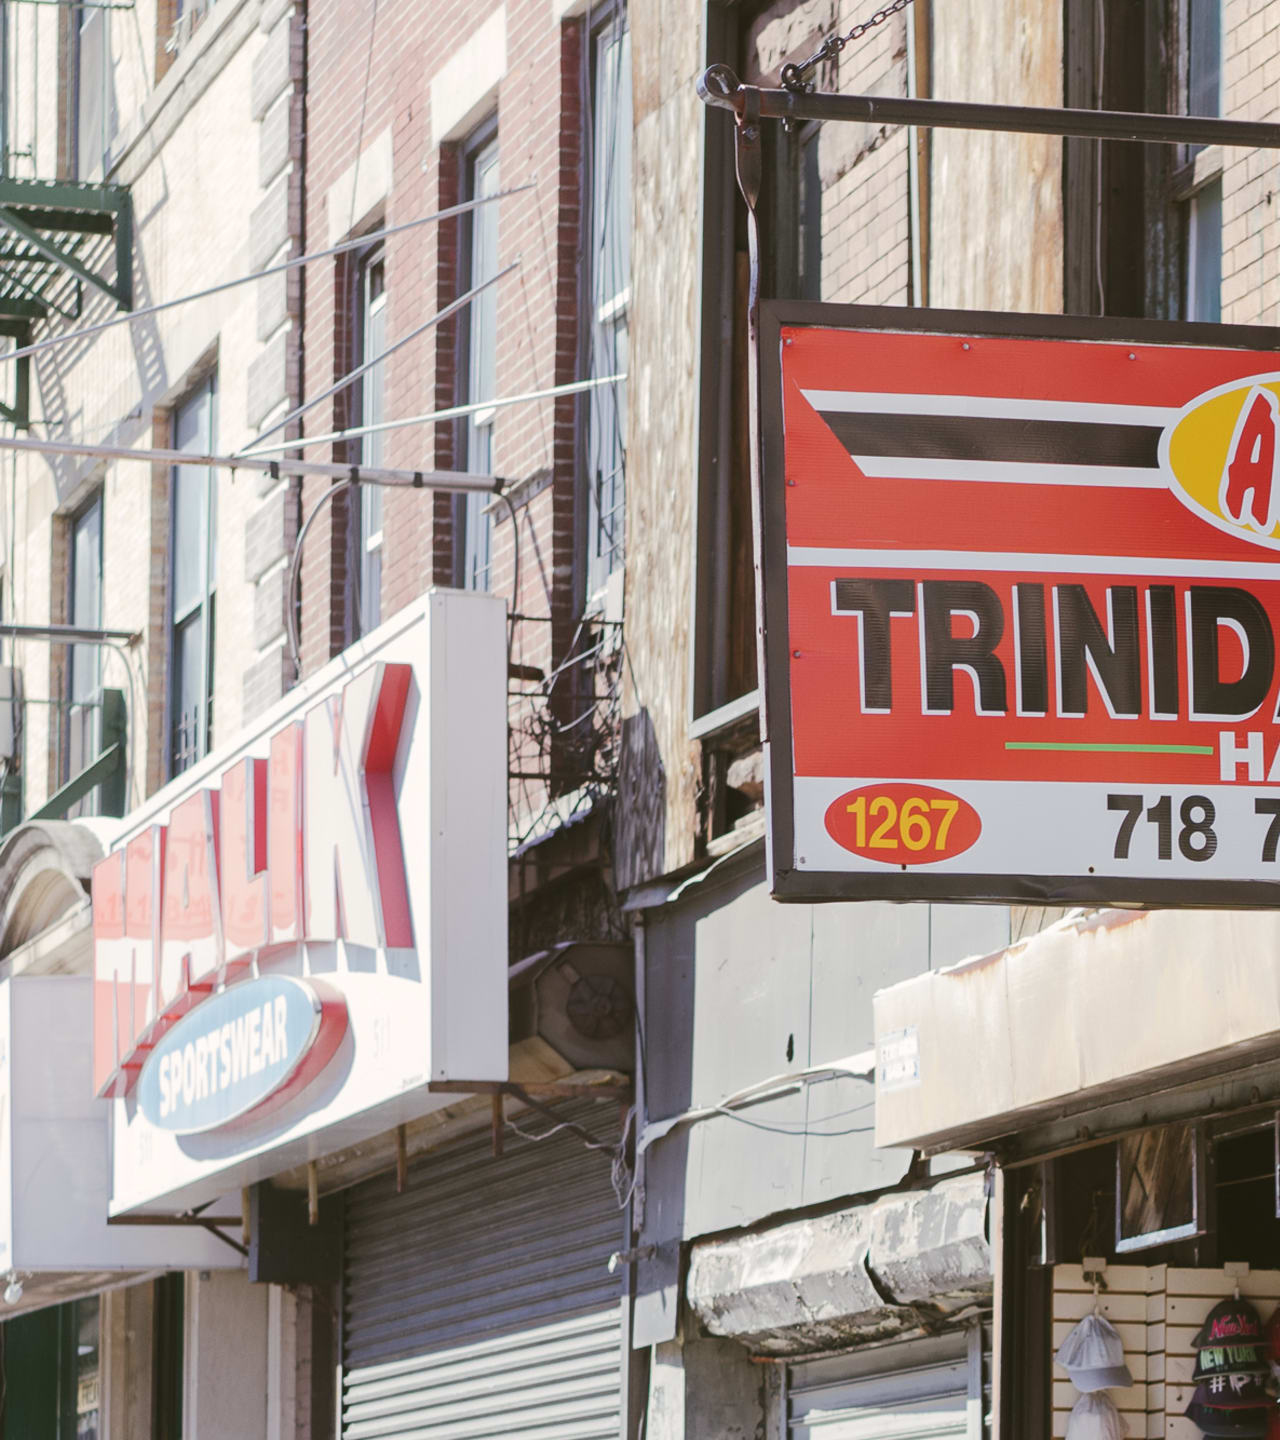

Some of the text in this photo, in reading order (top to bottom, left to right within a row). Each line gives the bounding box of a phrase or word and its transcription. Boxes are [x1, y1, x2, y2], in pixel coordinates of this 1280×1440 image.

[844, 796, 959, 851] 1267
[1107, 795, 1217, 862] 718
[93, 662, 414, 1098] MALIK
[159, 996, 287, 1115] SPORTSWEAR
[1201, 1348, 1224, 1371] NEW
[1225, 1346, 1257, 1363] YORK
